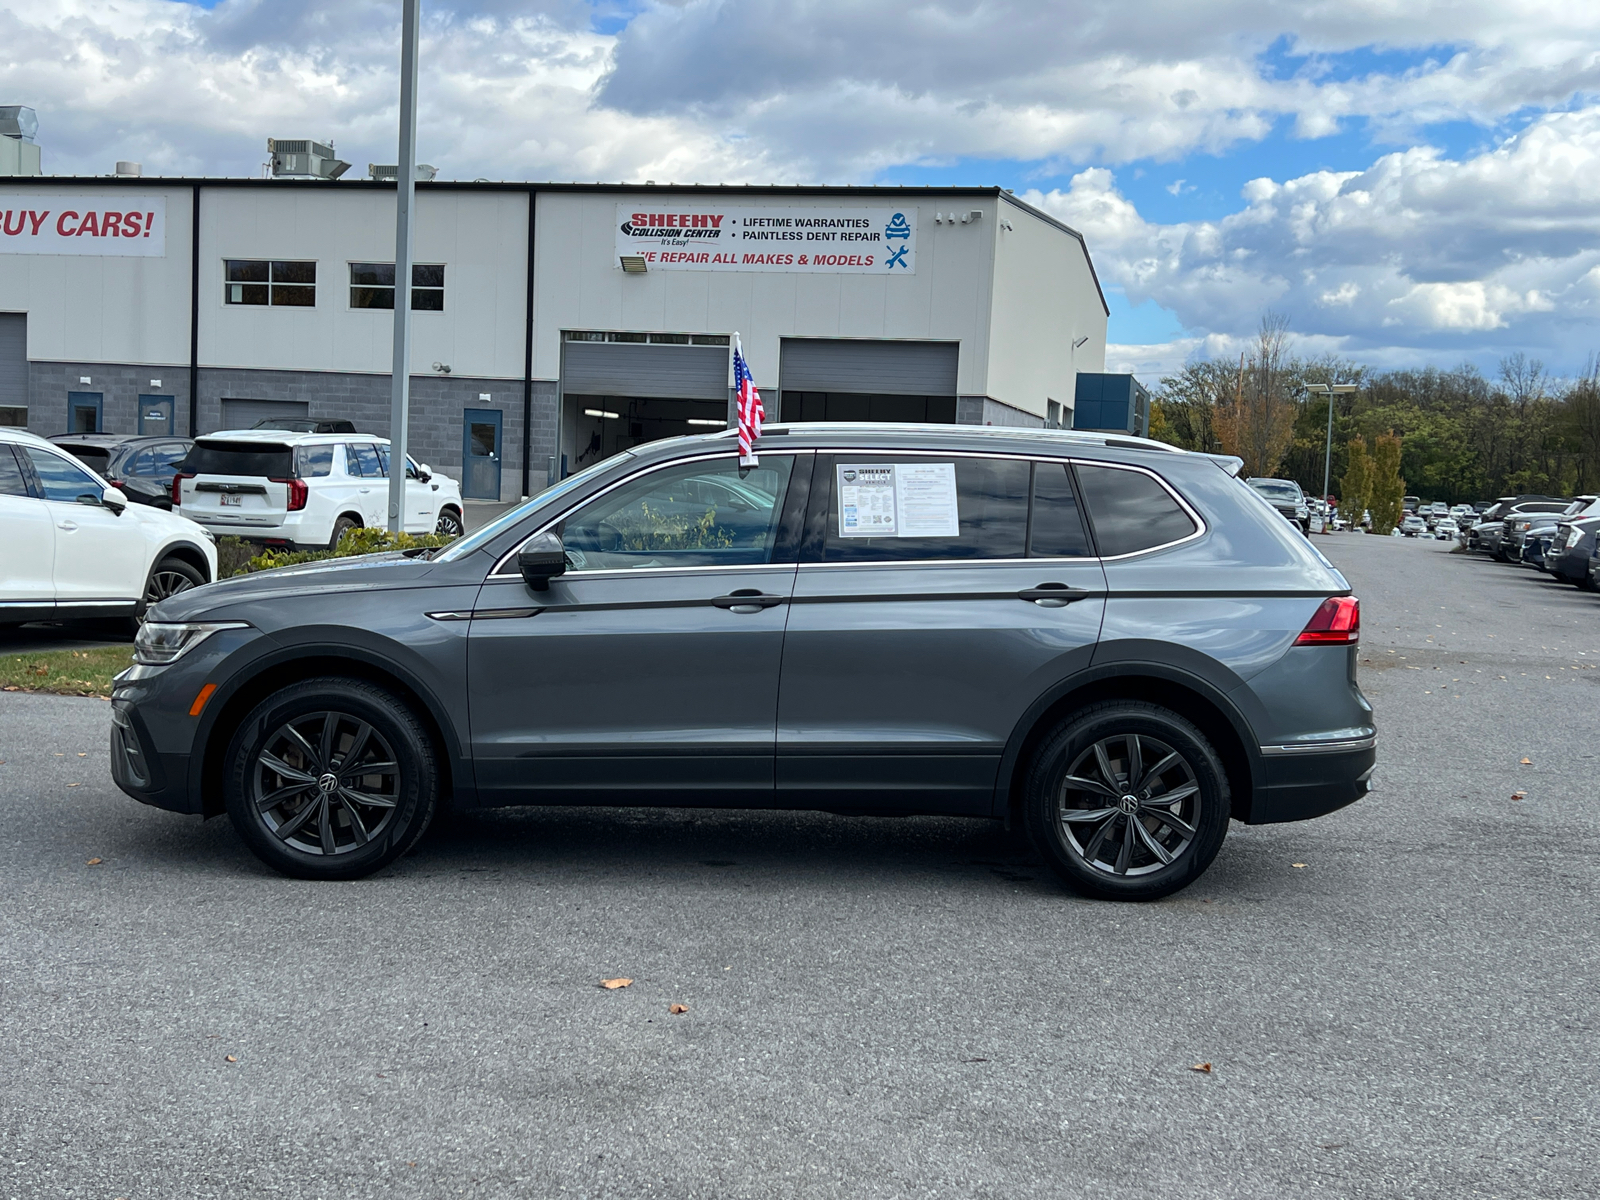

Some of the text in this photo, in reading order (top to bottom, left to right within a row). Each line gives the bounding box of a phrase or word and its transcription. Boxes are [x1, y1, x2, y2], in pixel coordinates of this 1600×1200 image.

[56, 210, 155, 238] CARS!
[631, 212, 724, 228] SHEEHY
[743, 217, 870, 228] LIFETIME WARRANTIES
[631, 227, 722, 239] COLLISION CENTER
[742, 230, 881, 242] PAINTLESS DENT REPAIR
[660, 238, 690, 247] It's Easy!
[660, 252, 710, 263] REPAIR
[711, 253, 738, 264] ALL
[742, 253, 794, 265] MAKES
[797, 254, 809, 265] &
[812, 254, 875, 267] MODELS
